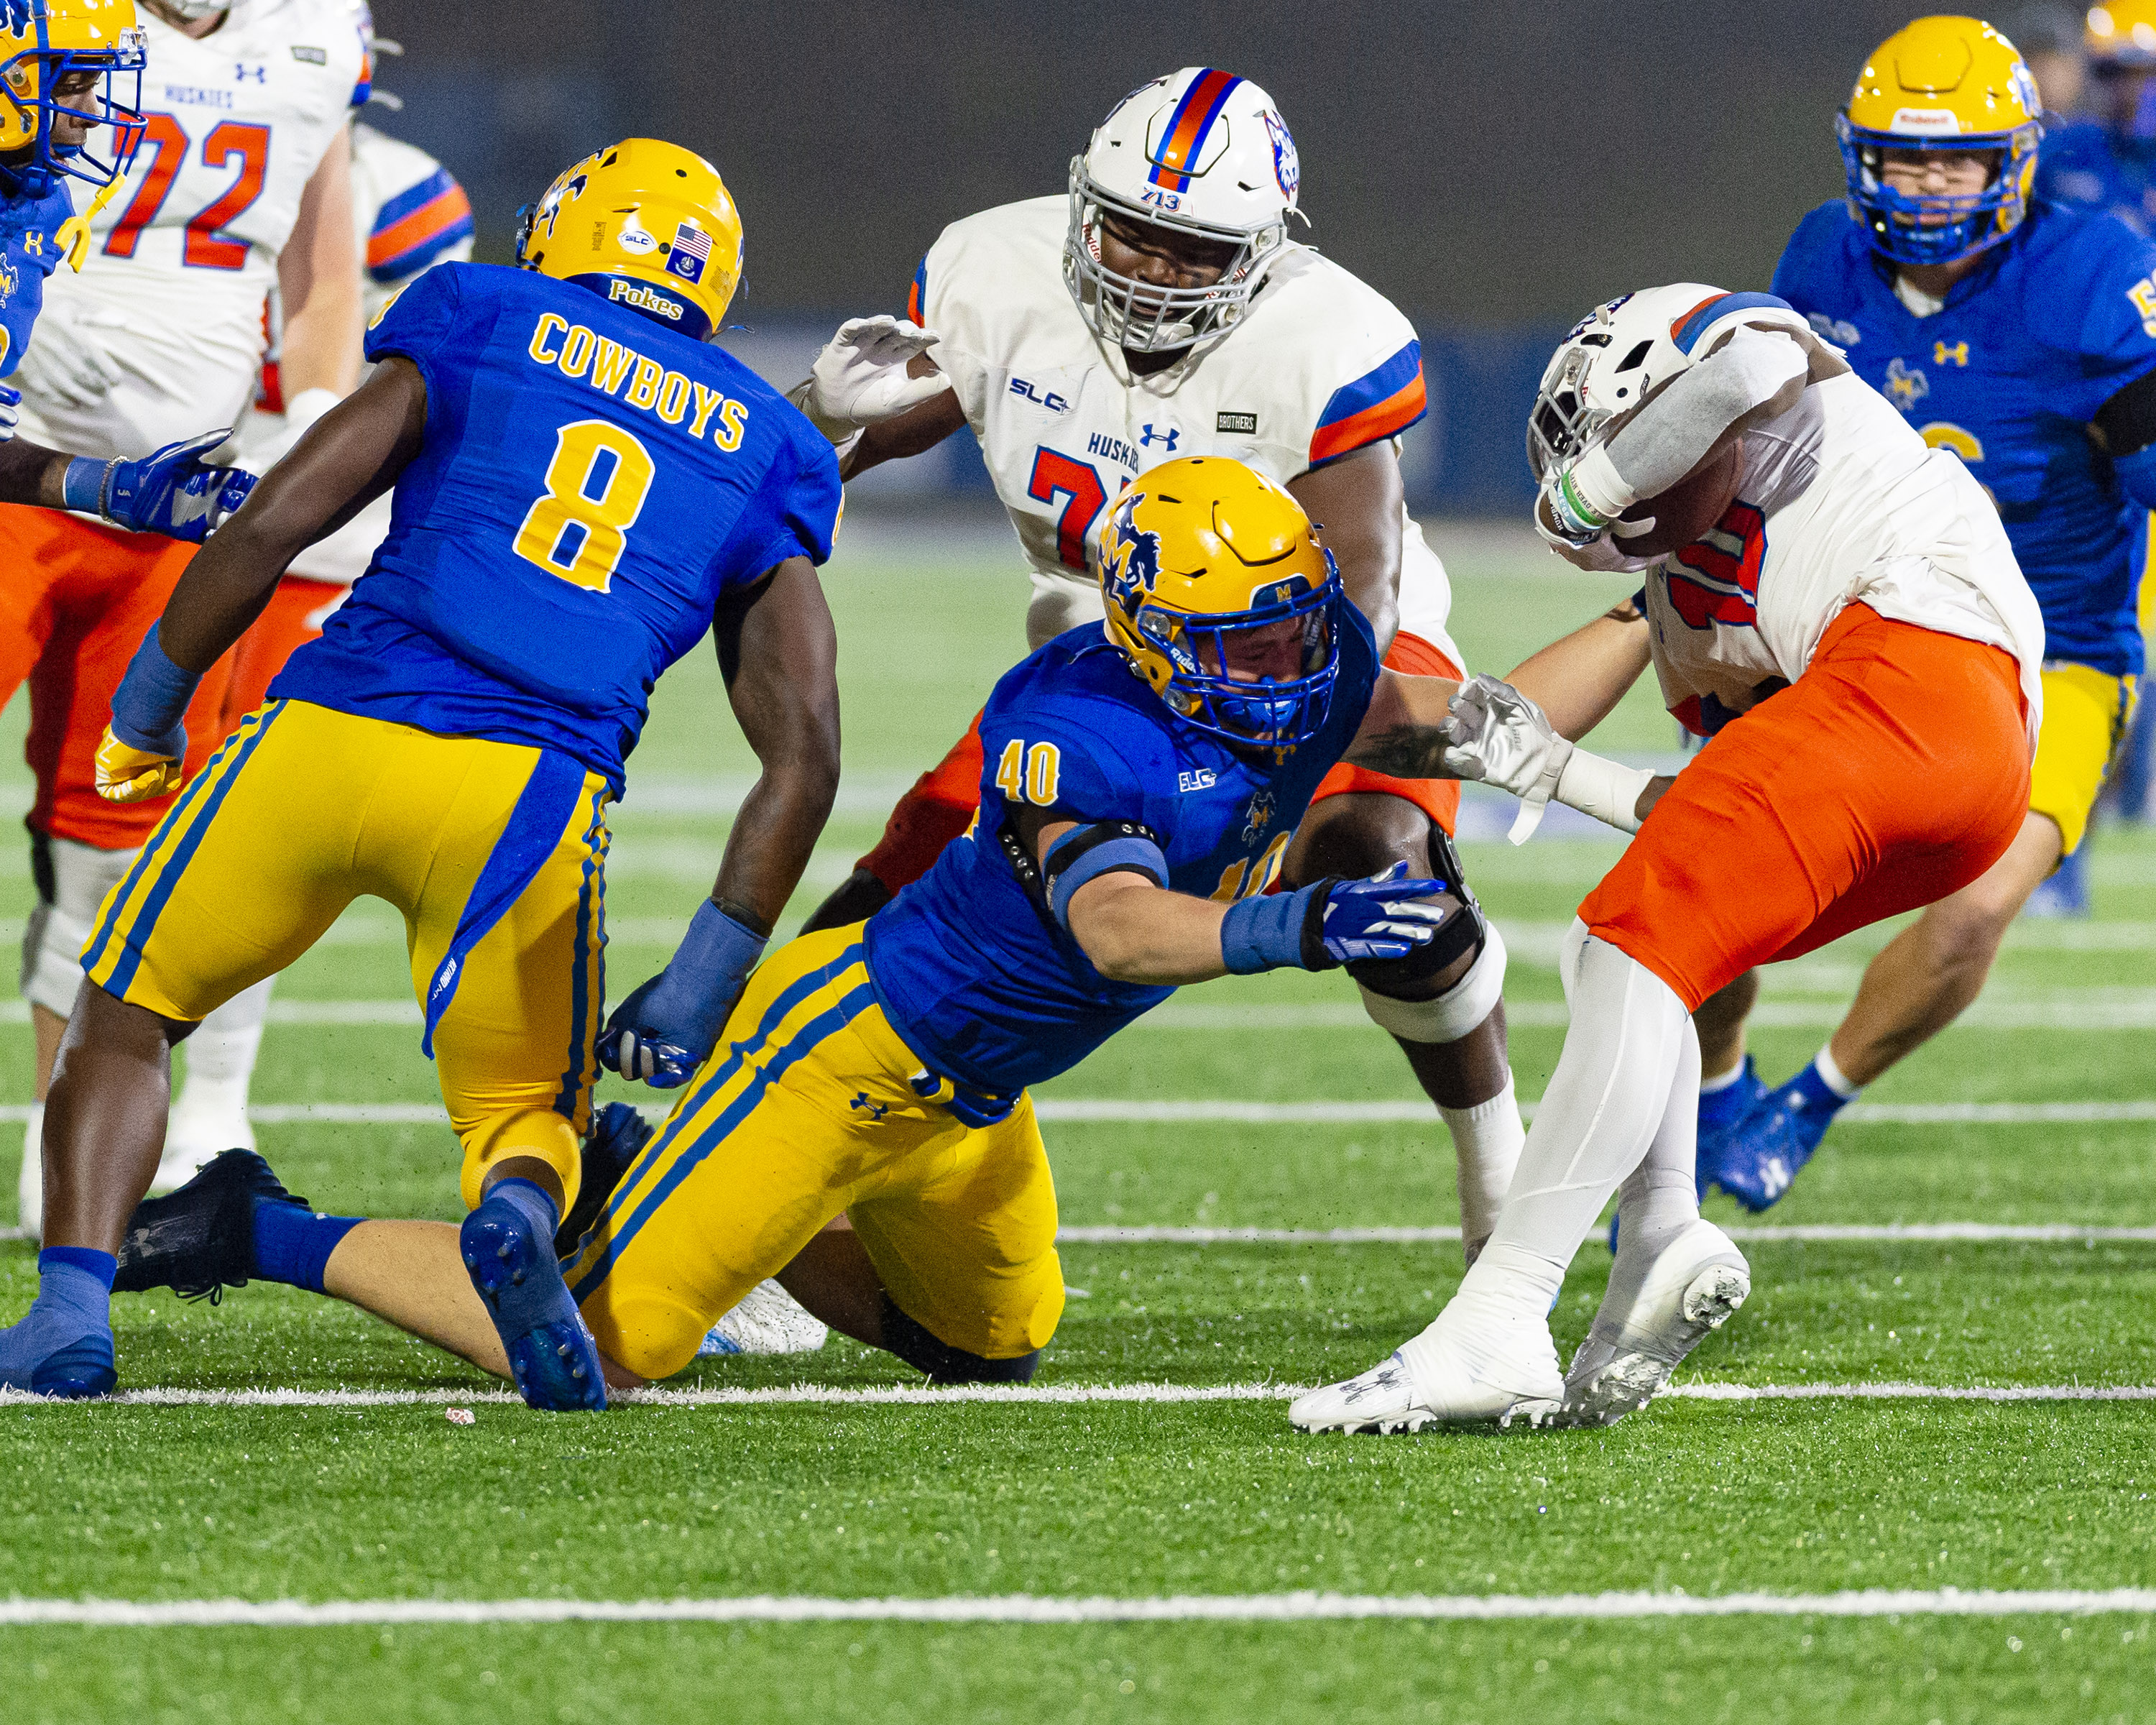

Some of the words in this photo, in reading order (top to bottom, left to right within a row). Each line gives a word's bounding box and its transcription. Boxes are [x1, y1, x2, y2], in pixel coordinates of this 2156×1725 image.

[101, 110, 272, 271] 72
[1141, 185, 1181, 211] 713
[625, 234, 650, 246] SLC
[608, 279, 683, 321] Pokes
[529, 313, 749, 453] COWBOYS
[1009, 377, 1072, 413] SLC
[1218, 415, 1254, 431] BROTHERS
[117, 489, 132, 497] UA
[512, 419, 655, 594] 8
[1027, 444, 1133, 569] 7
[1577, 491, 1592, 509] OVER
[1276, 584, 1292, 603] M
[995, 739, 1061, 806] 40
[1179, 768, 1217, 792] SLC
